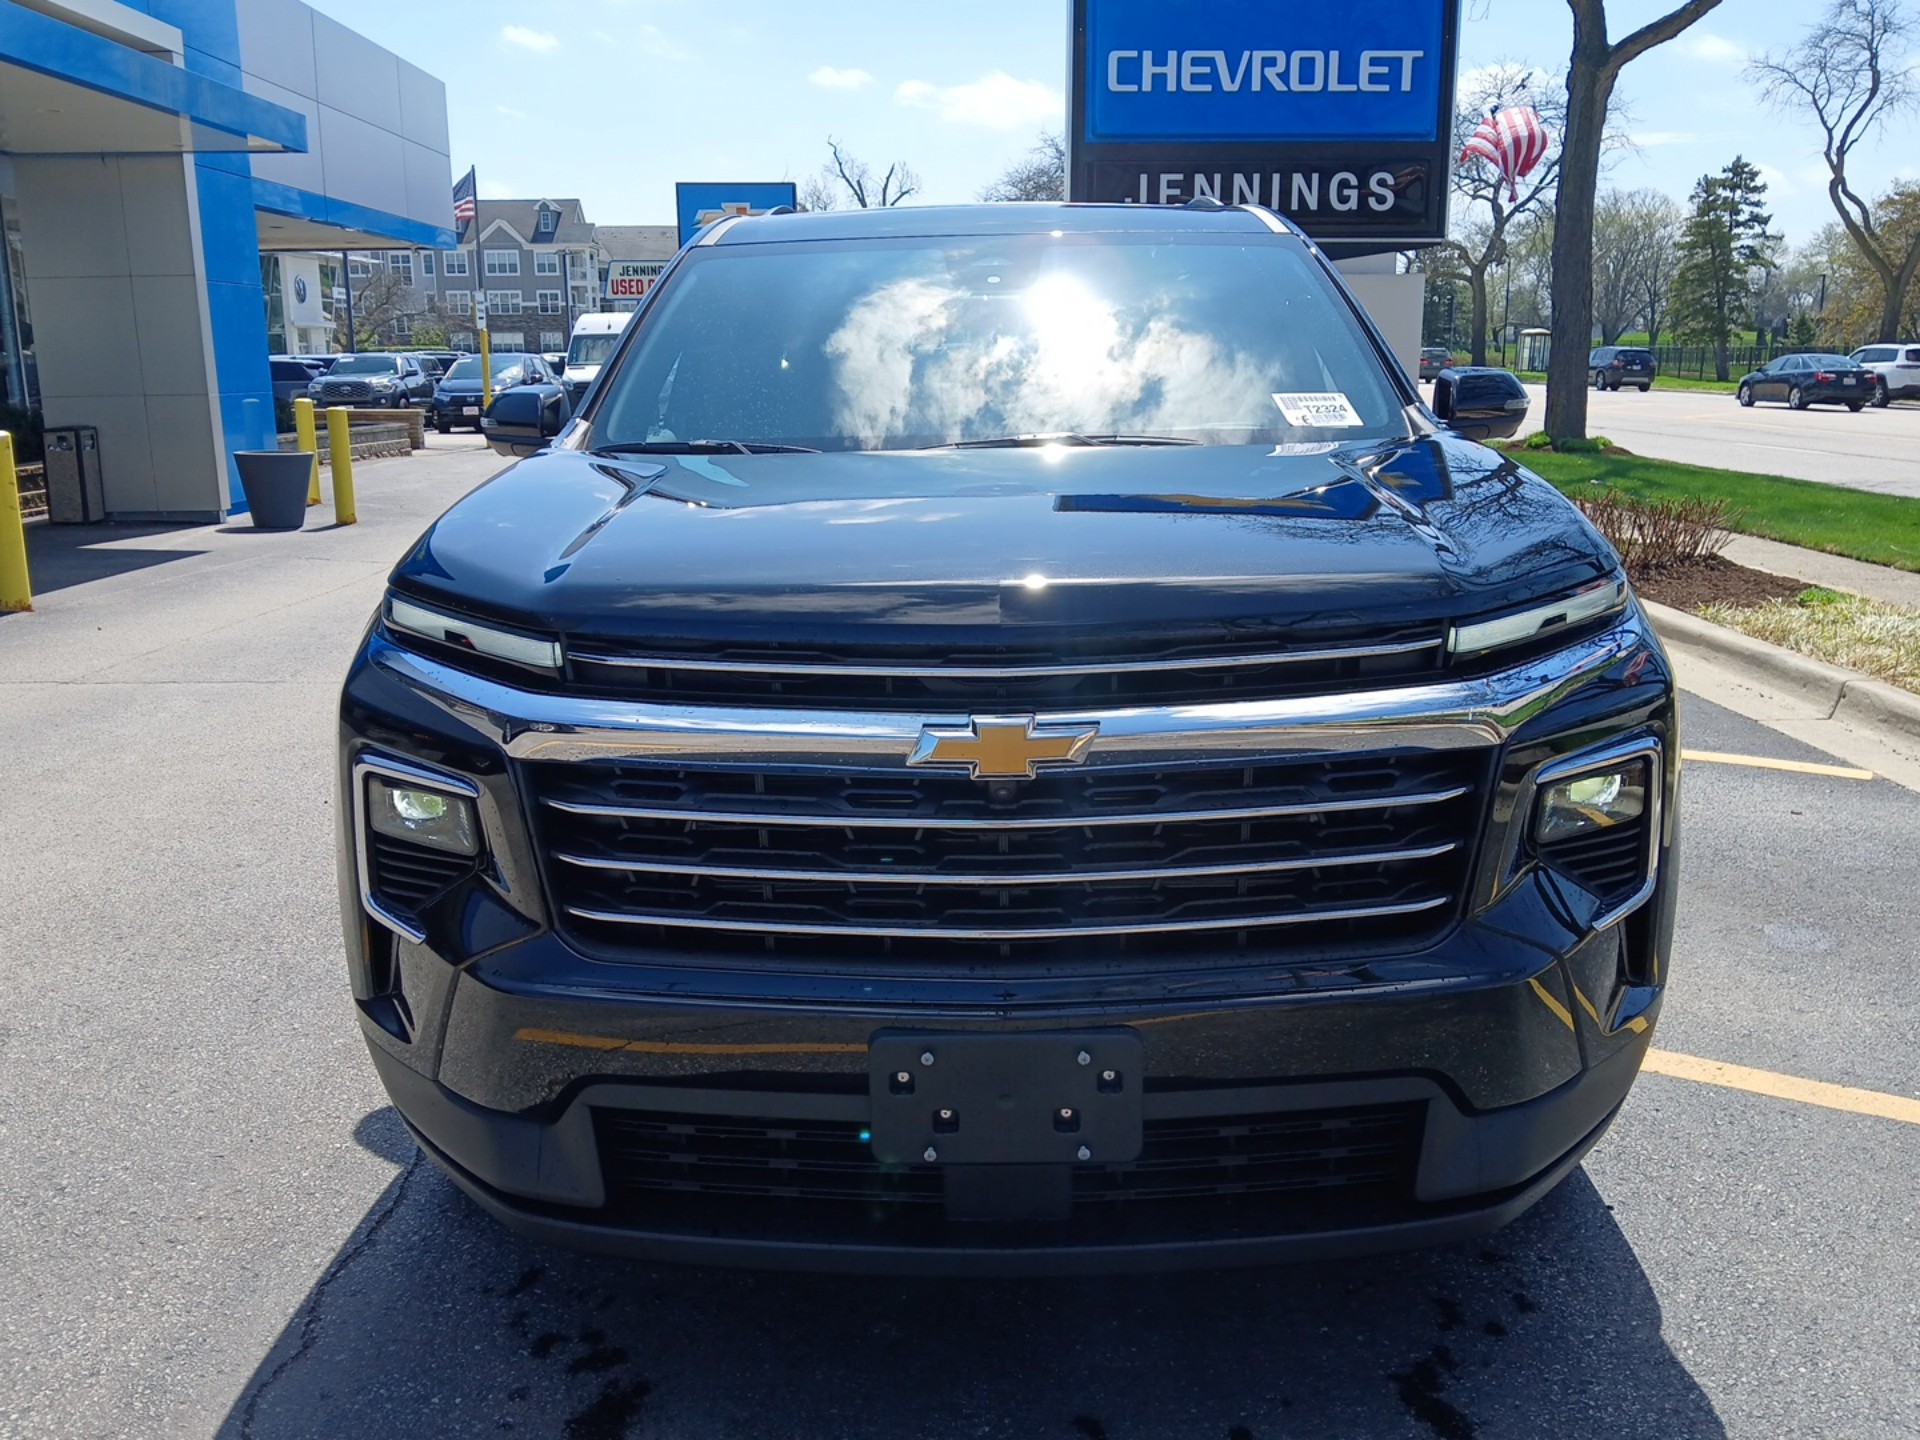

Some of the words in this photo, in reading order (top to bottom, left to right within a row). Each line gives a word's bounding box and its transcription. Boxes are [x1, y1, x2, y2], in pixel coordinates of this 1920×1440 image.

[1108, 50, 1424, 92] CHEVROLET
[1125, 171, 1396, 211] JENNINGS
[611, 279, 644, 295] USED
